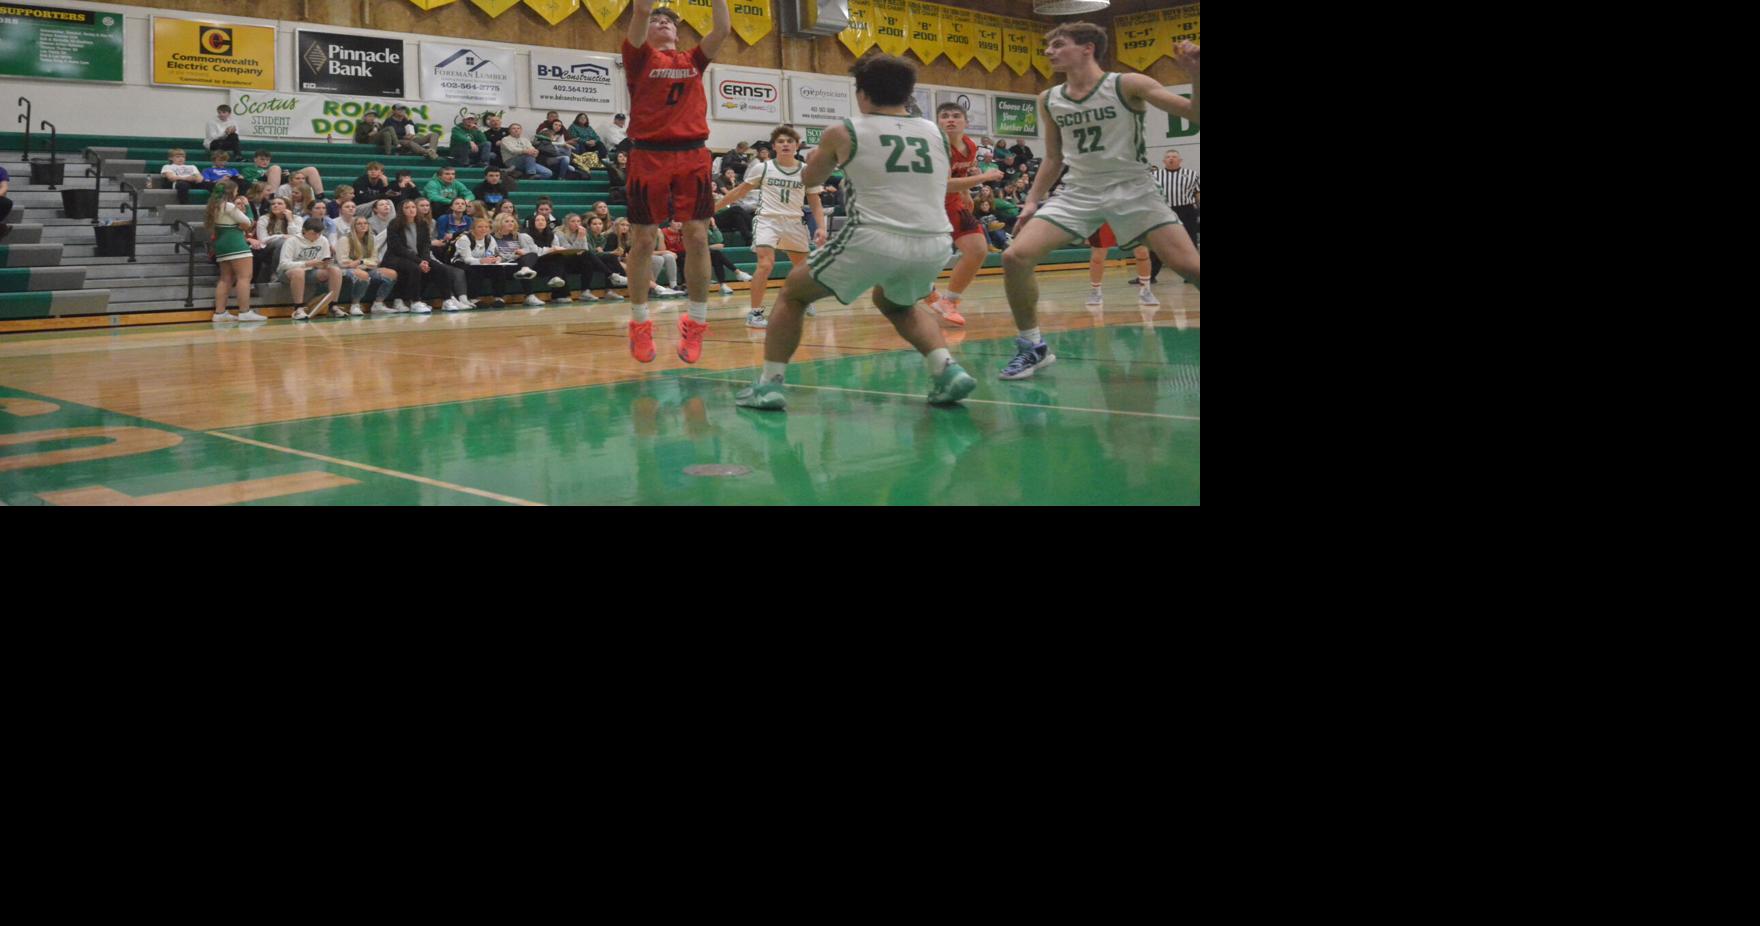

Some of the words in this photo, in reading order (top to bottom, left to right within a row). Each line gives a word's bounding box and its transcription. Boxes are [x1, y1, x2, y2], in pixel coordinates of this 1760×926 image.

[0, 7, 86, 21] SUPPORTERS
[734, 4, 763, 16] 2001
[172, 52, 259, 67] Commonwealth
[328, 44, 400, 64] Pinnacle
[167, 61, 209, 71] Electric
[212, 64, 263, 77] Company
[328, 60, 373, 77] Bank
[560, 70, 611, 83] Construction
[722, 84, 773, 98] ERNST
[233, 94, 300, 116] Scotus
[998, 101, 1021, 111] Choose
[1022, 103, 1035, 112] Life
[251, 115, 291, 127] STUDENT
[1002, 112, 1018, 121] Your
[1056, 106, 1118, 128] SCOTUS
[252, 125, 289, 137] SECTION
[1072, 125, 1106, 154] 22
[879, 134, 935, 174] 23
[767, 177, 804, 189] SCOTUS
[780, 188, 790, 204] 11
